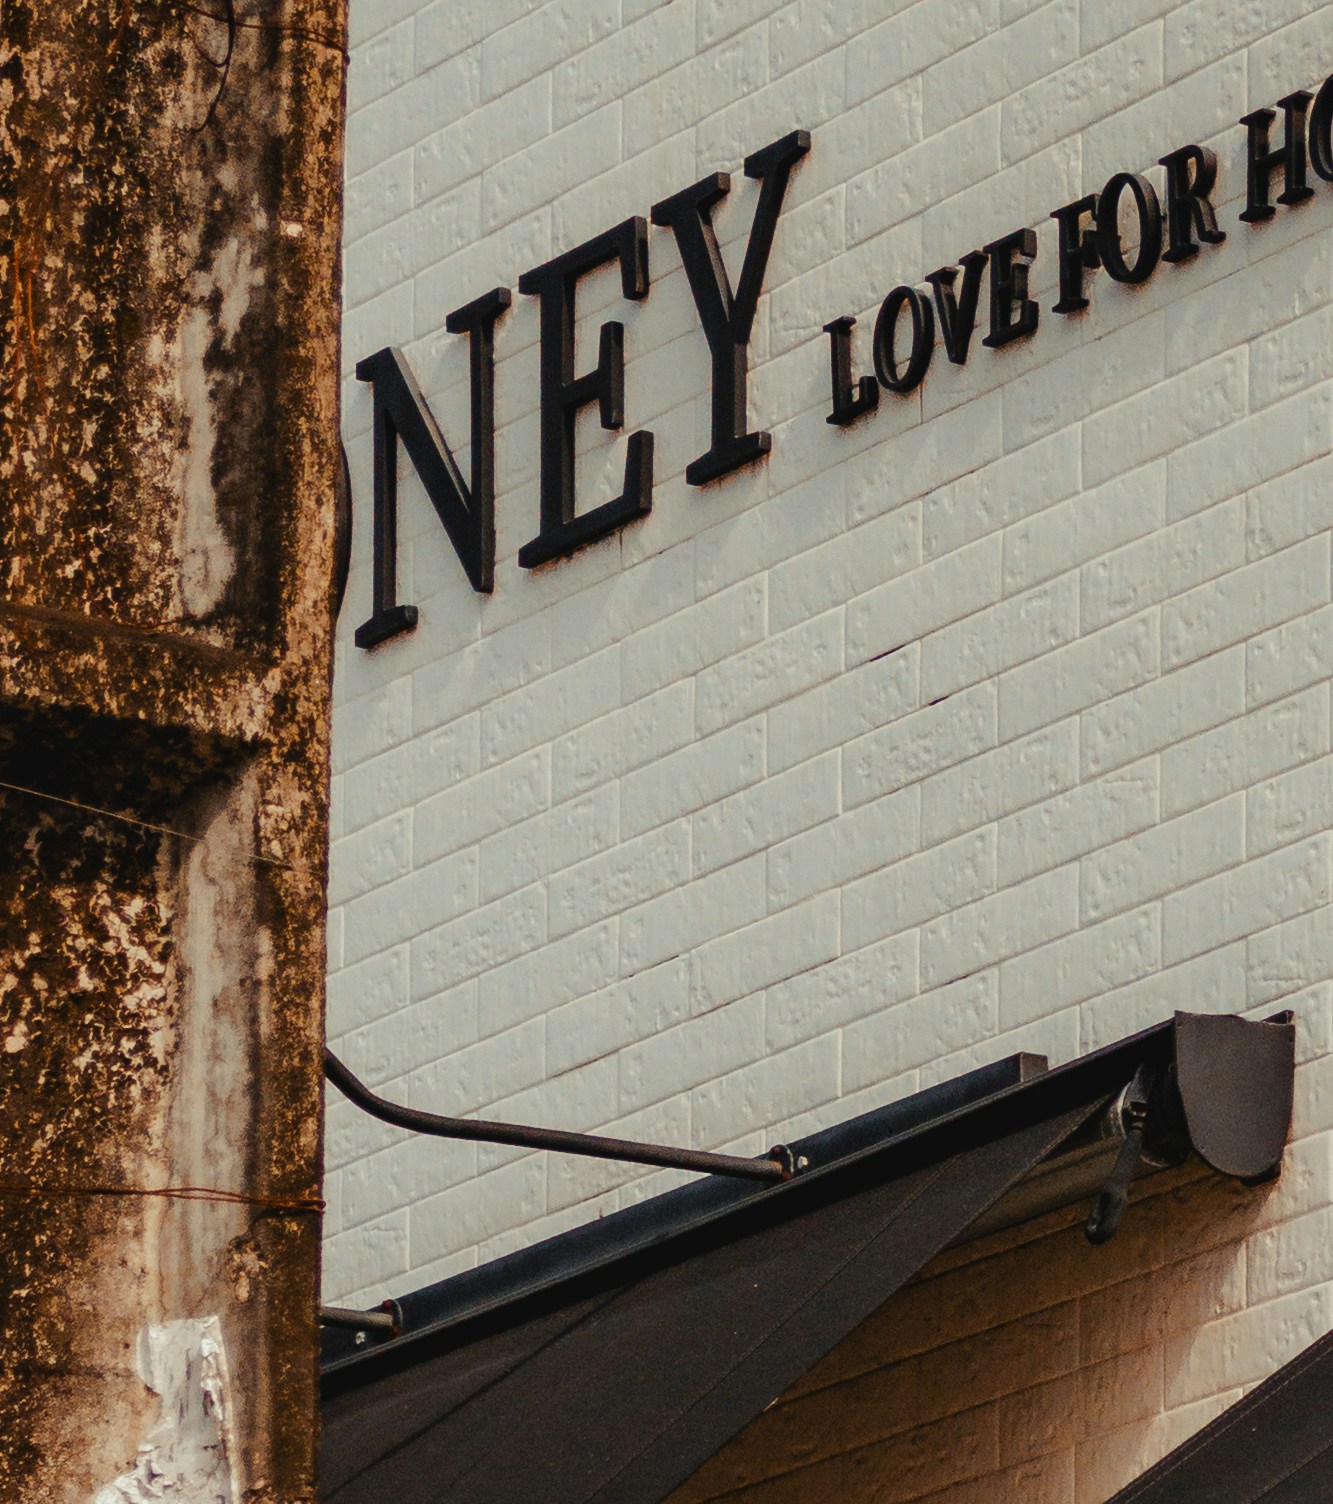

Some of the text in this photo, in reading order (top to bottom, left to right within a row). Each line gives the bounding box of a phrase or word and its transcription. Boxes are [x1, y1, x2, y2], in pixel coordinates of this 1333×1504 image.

[336, 129, 812, 648] NEY
[823, 227, 1040, 426] LOVE
[1050, 144, 1226, 314] FOR
